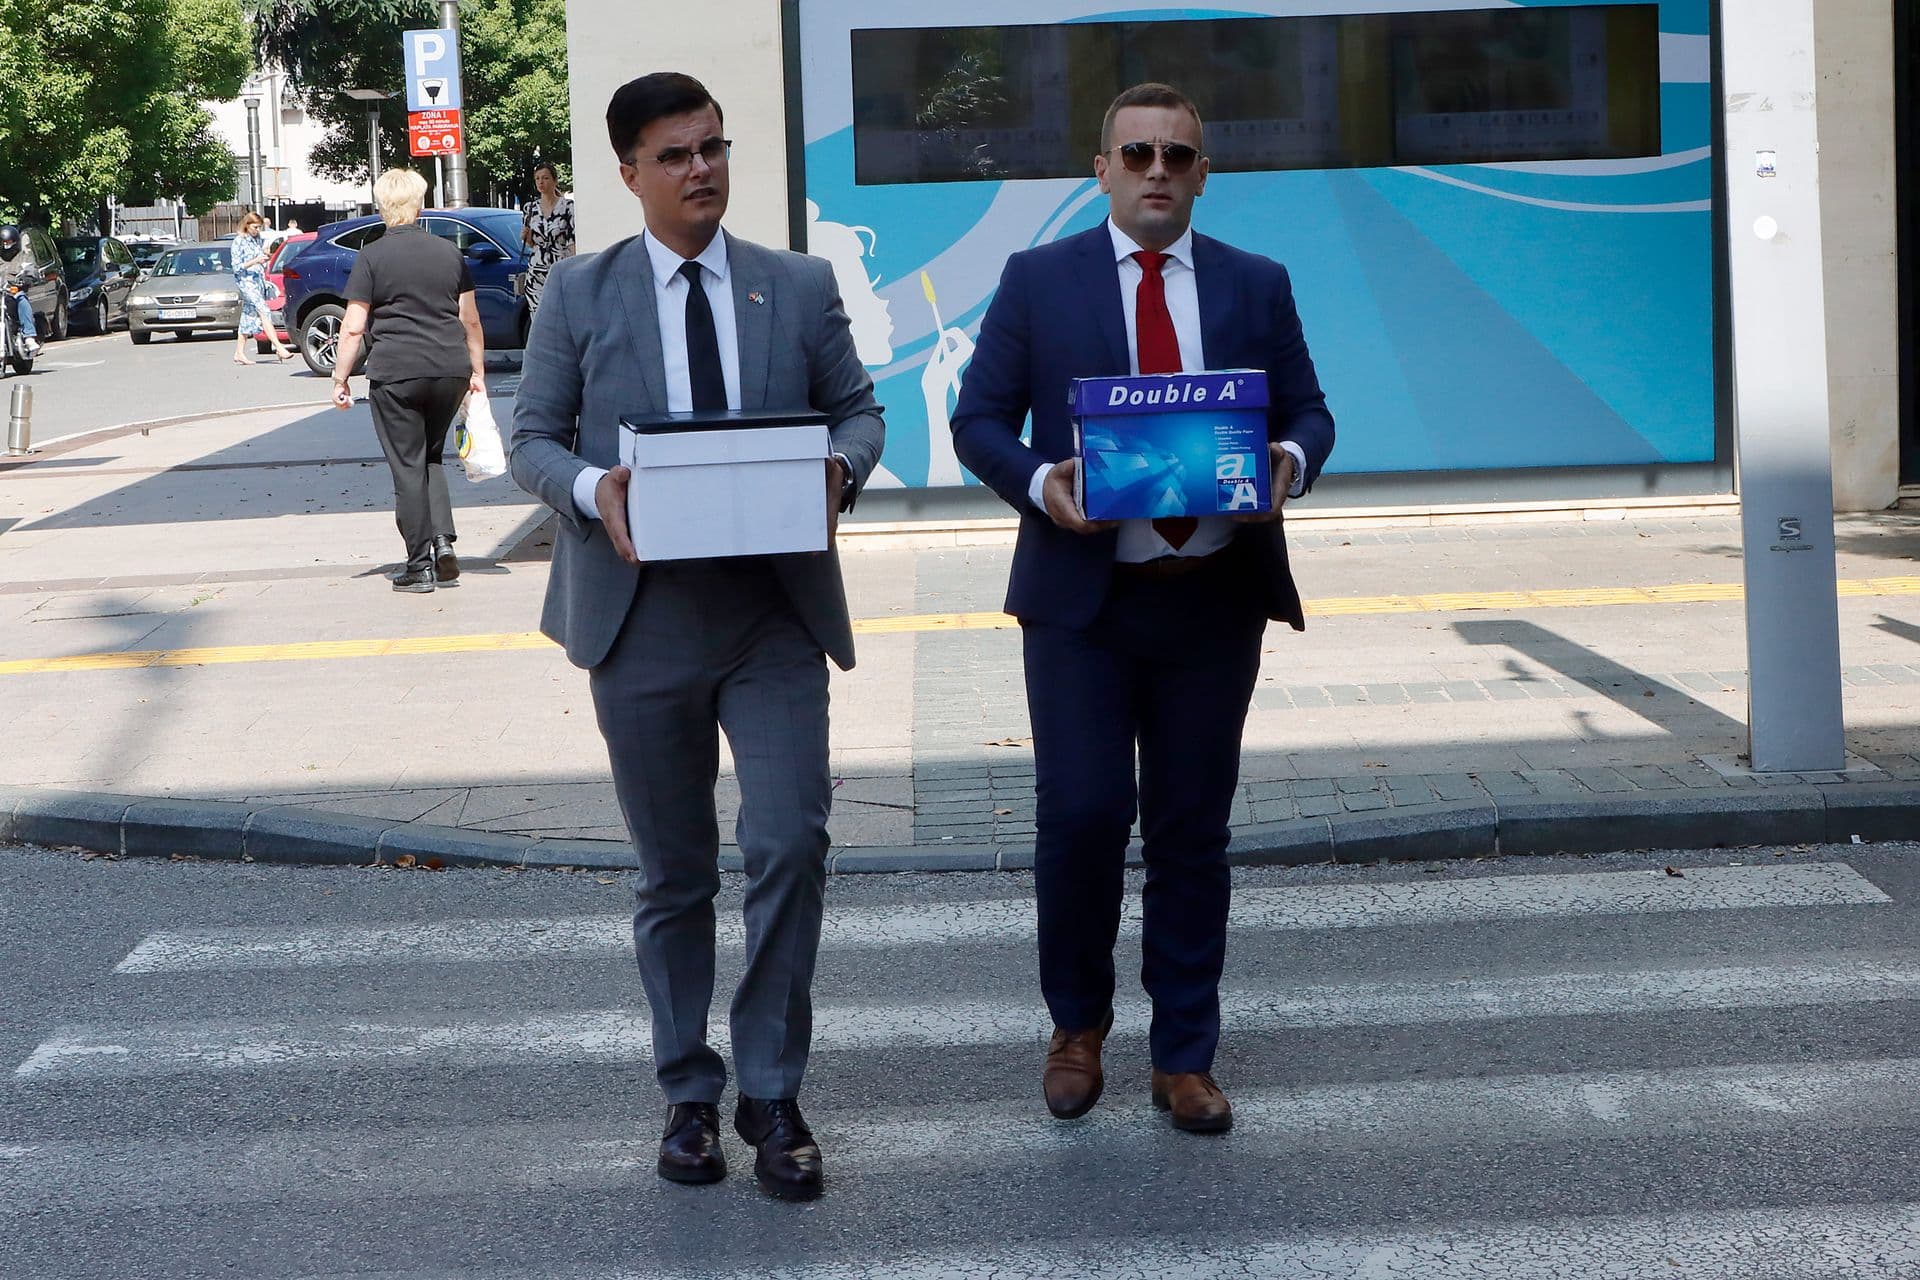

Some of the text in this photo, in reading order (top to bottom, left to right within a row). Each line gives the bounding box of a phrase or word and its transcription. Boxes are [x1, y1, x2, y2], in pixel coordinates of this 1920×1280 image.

[414, 33, 446, 76] P
[1108, 383, 1208, 406] Double
[1228, 483, 1258, 510] A
